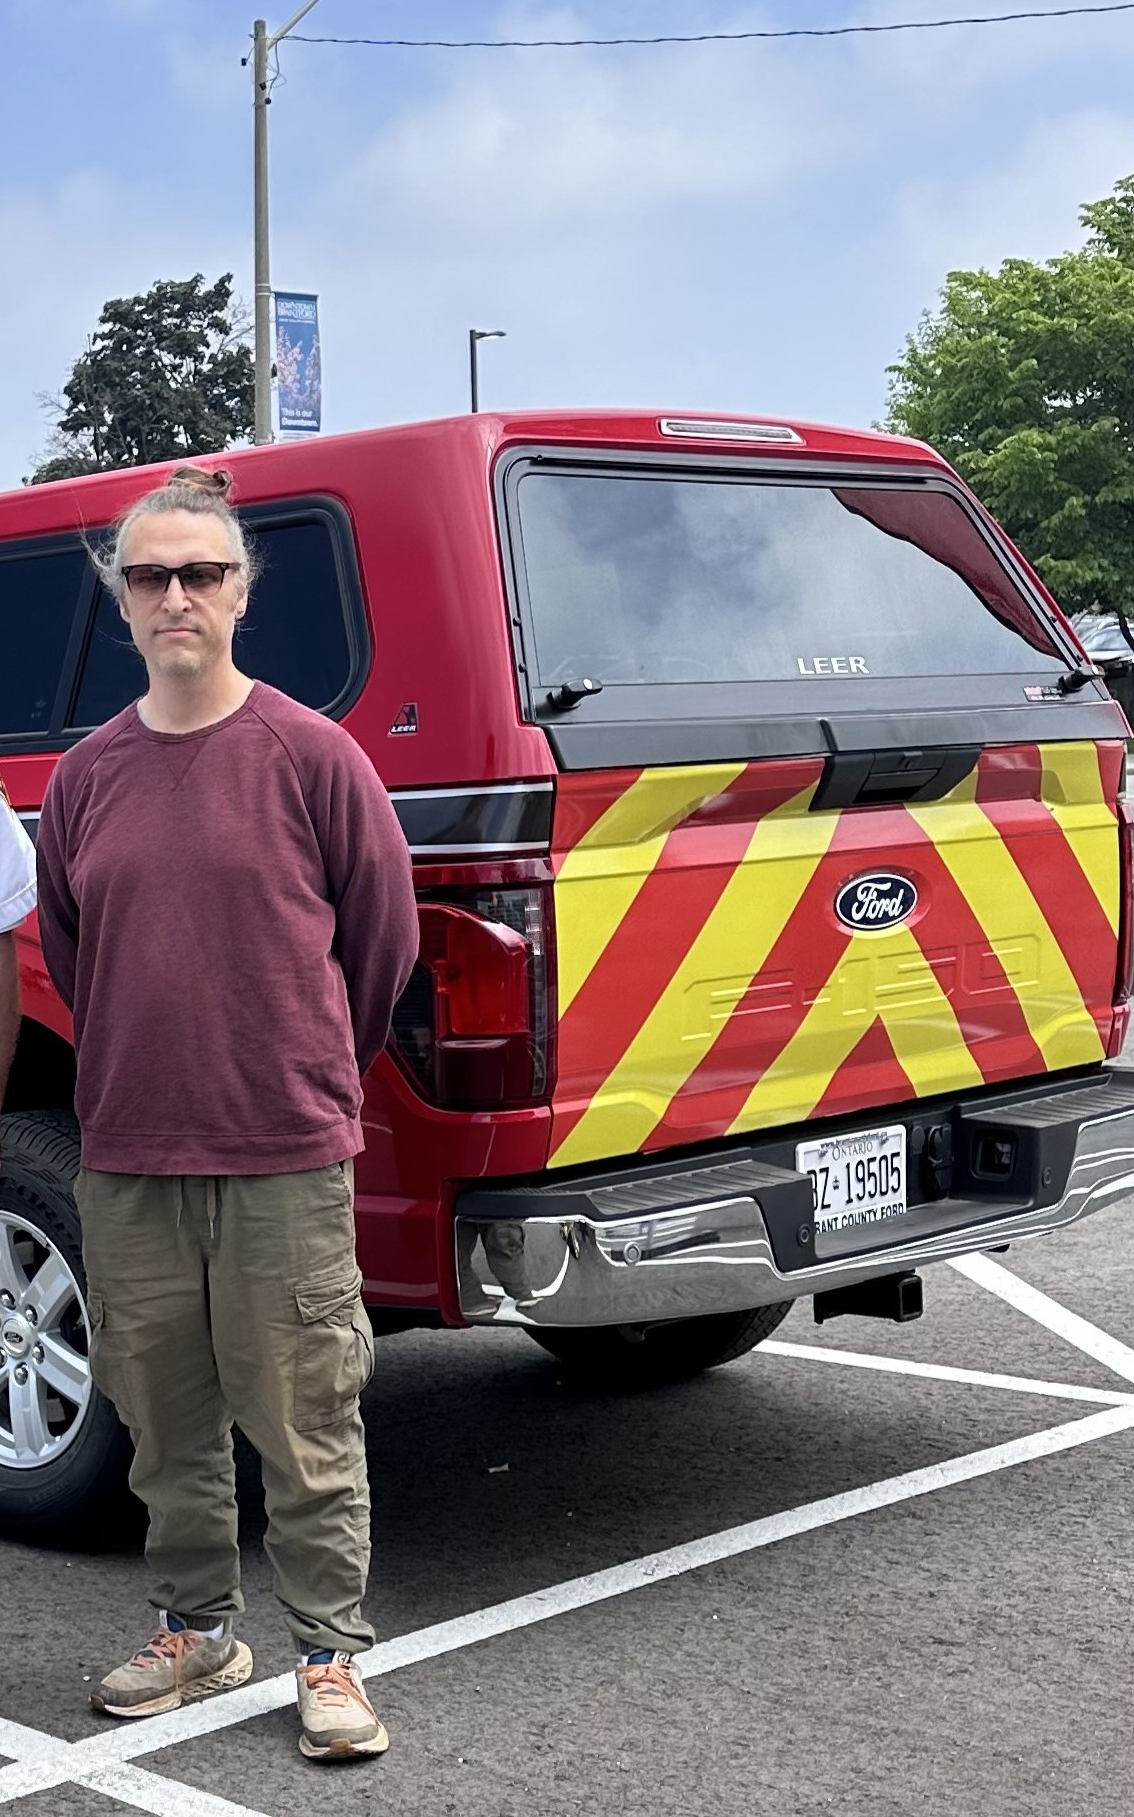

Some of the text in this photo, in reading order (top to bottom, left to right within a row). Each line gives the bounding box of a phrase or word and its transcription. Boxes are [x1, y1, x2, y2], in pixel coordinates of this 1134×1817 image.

[281, 407, 295, 416] This
[797, 656, 870, 676] LEER
[391, 725, 416, 733] LEER
[851, 882, 904, 920] Ford
[845, 1152, 901, 1205] 19505
[814, 1203, 904, 1234] RANT COUNTY FORD
